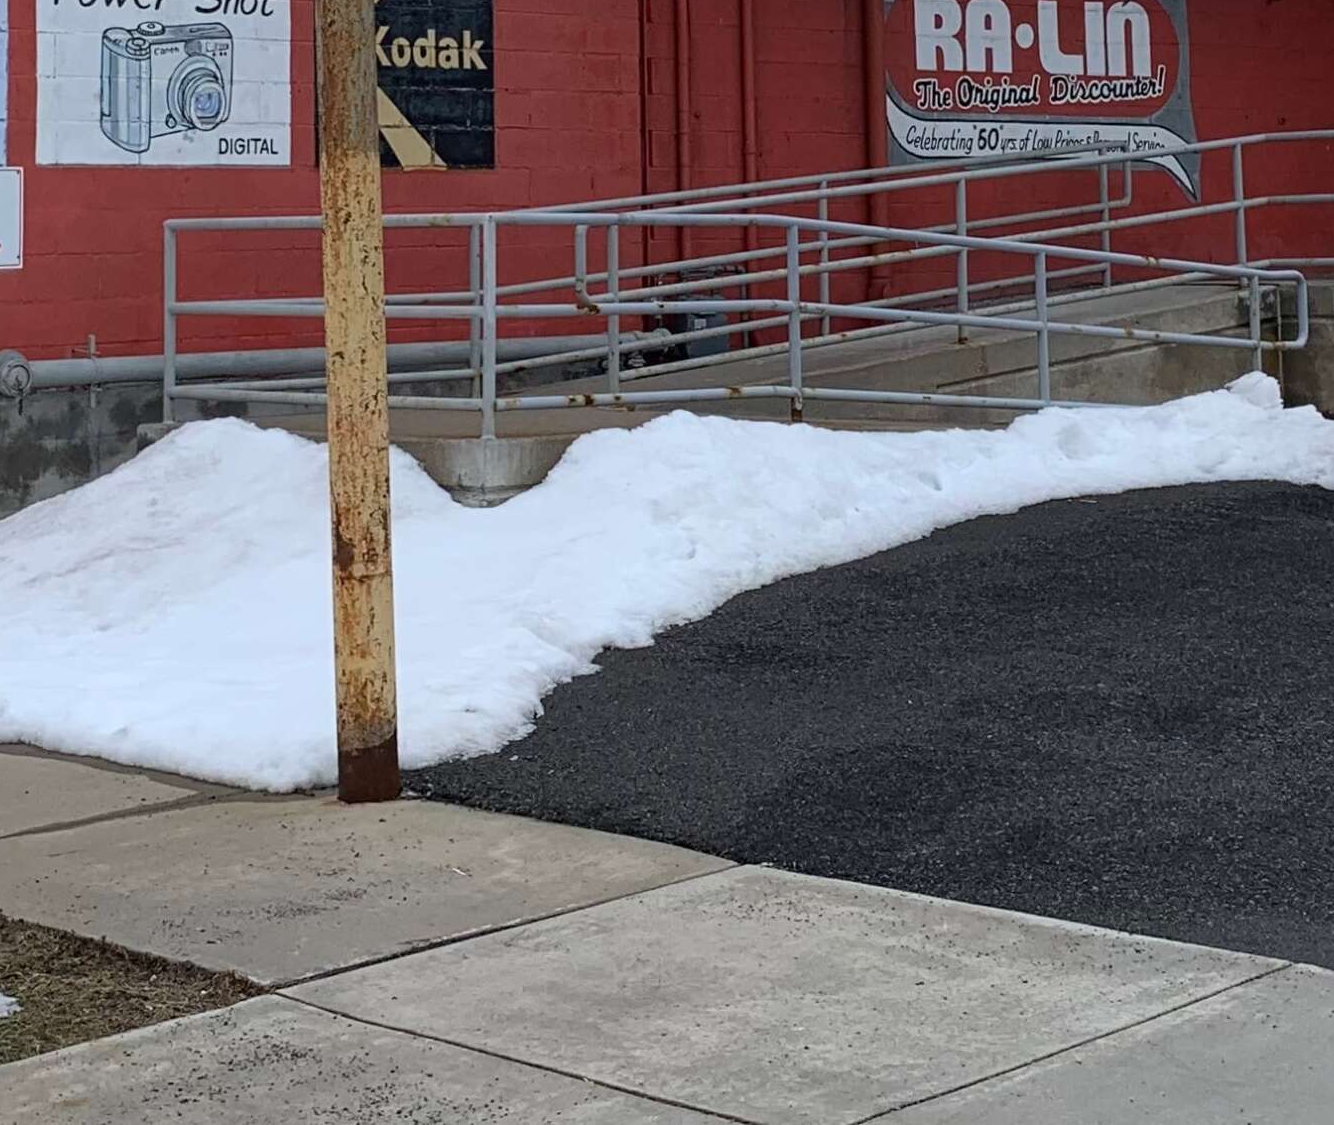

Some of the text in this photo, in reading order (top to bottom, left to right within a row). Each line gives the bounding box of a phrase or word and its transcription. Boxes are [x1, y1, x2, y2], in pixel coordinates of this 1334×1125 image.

[915, 64, 1166, 113] The Original Discounter!
[218, 137, 279, 155] DIGITAL
[905, 124, 974, 155] Celebrating
[1019, 128, 1033, 151] of
